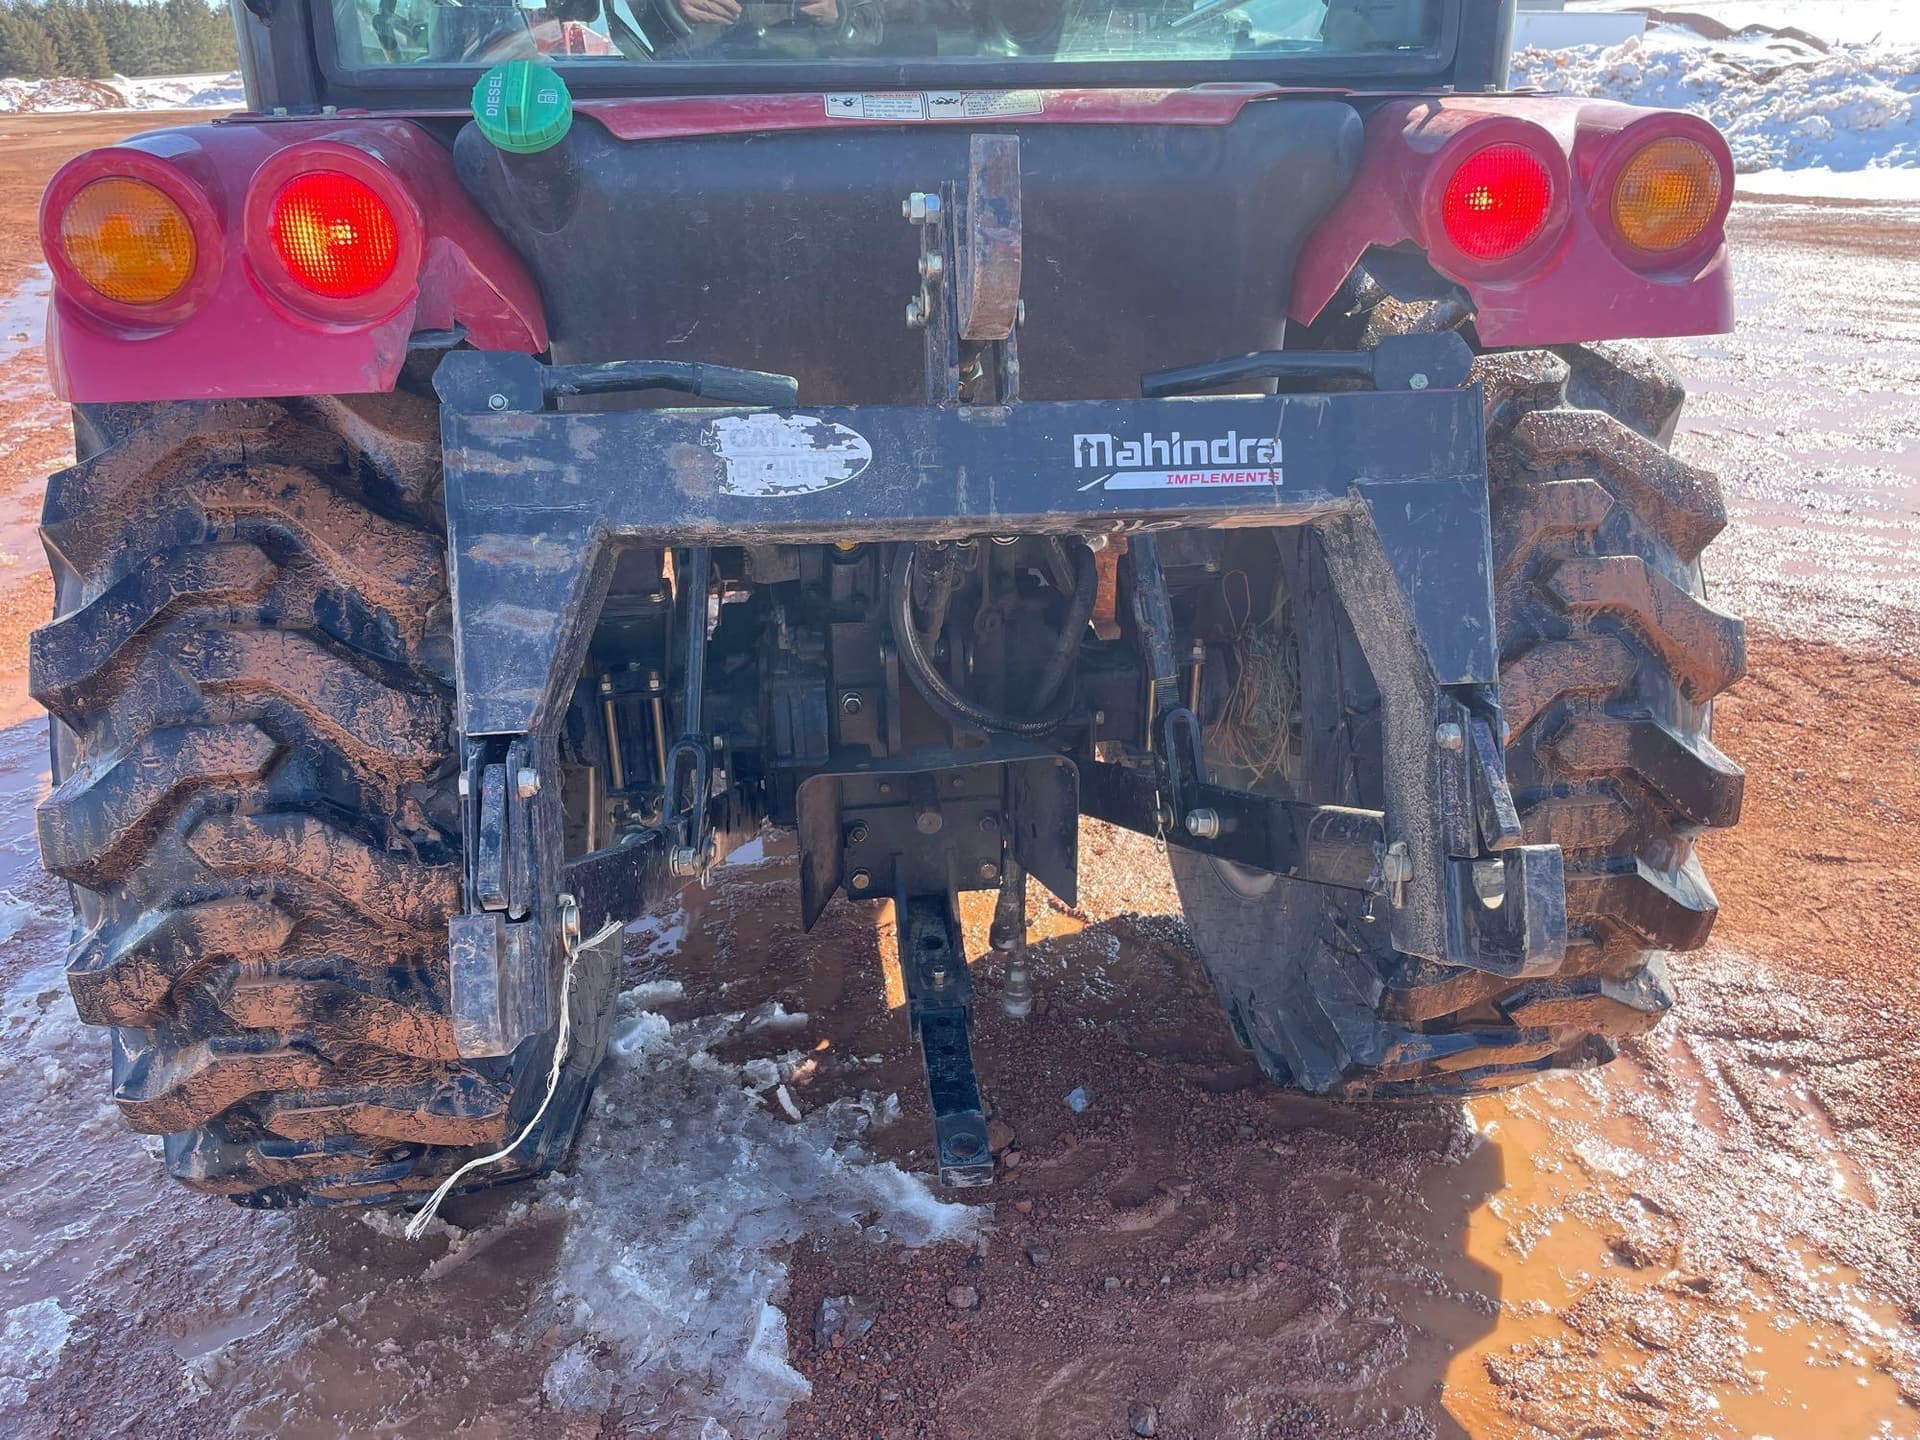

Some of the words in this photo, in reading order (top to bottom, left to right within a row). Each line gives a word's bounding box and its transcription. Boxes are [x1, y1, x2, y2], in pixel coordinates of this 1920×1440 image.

[486, 72, 503, 117] DIESEL
[1073, 430, 1283, 468] Mahindra
[1166, 471, 1280, 485] IMPLEMENTS
